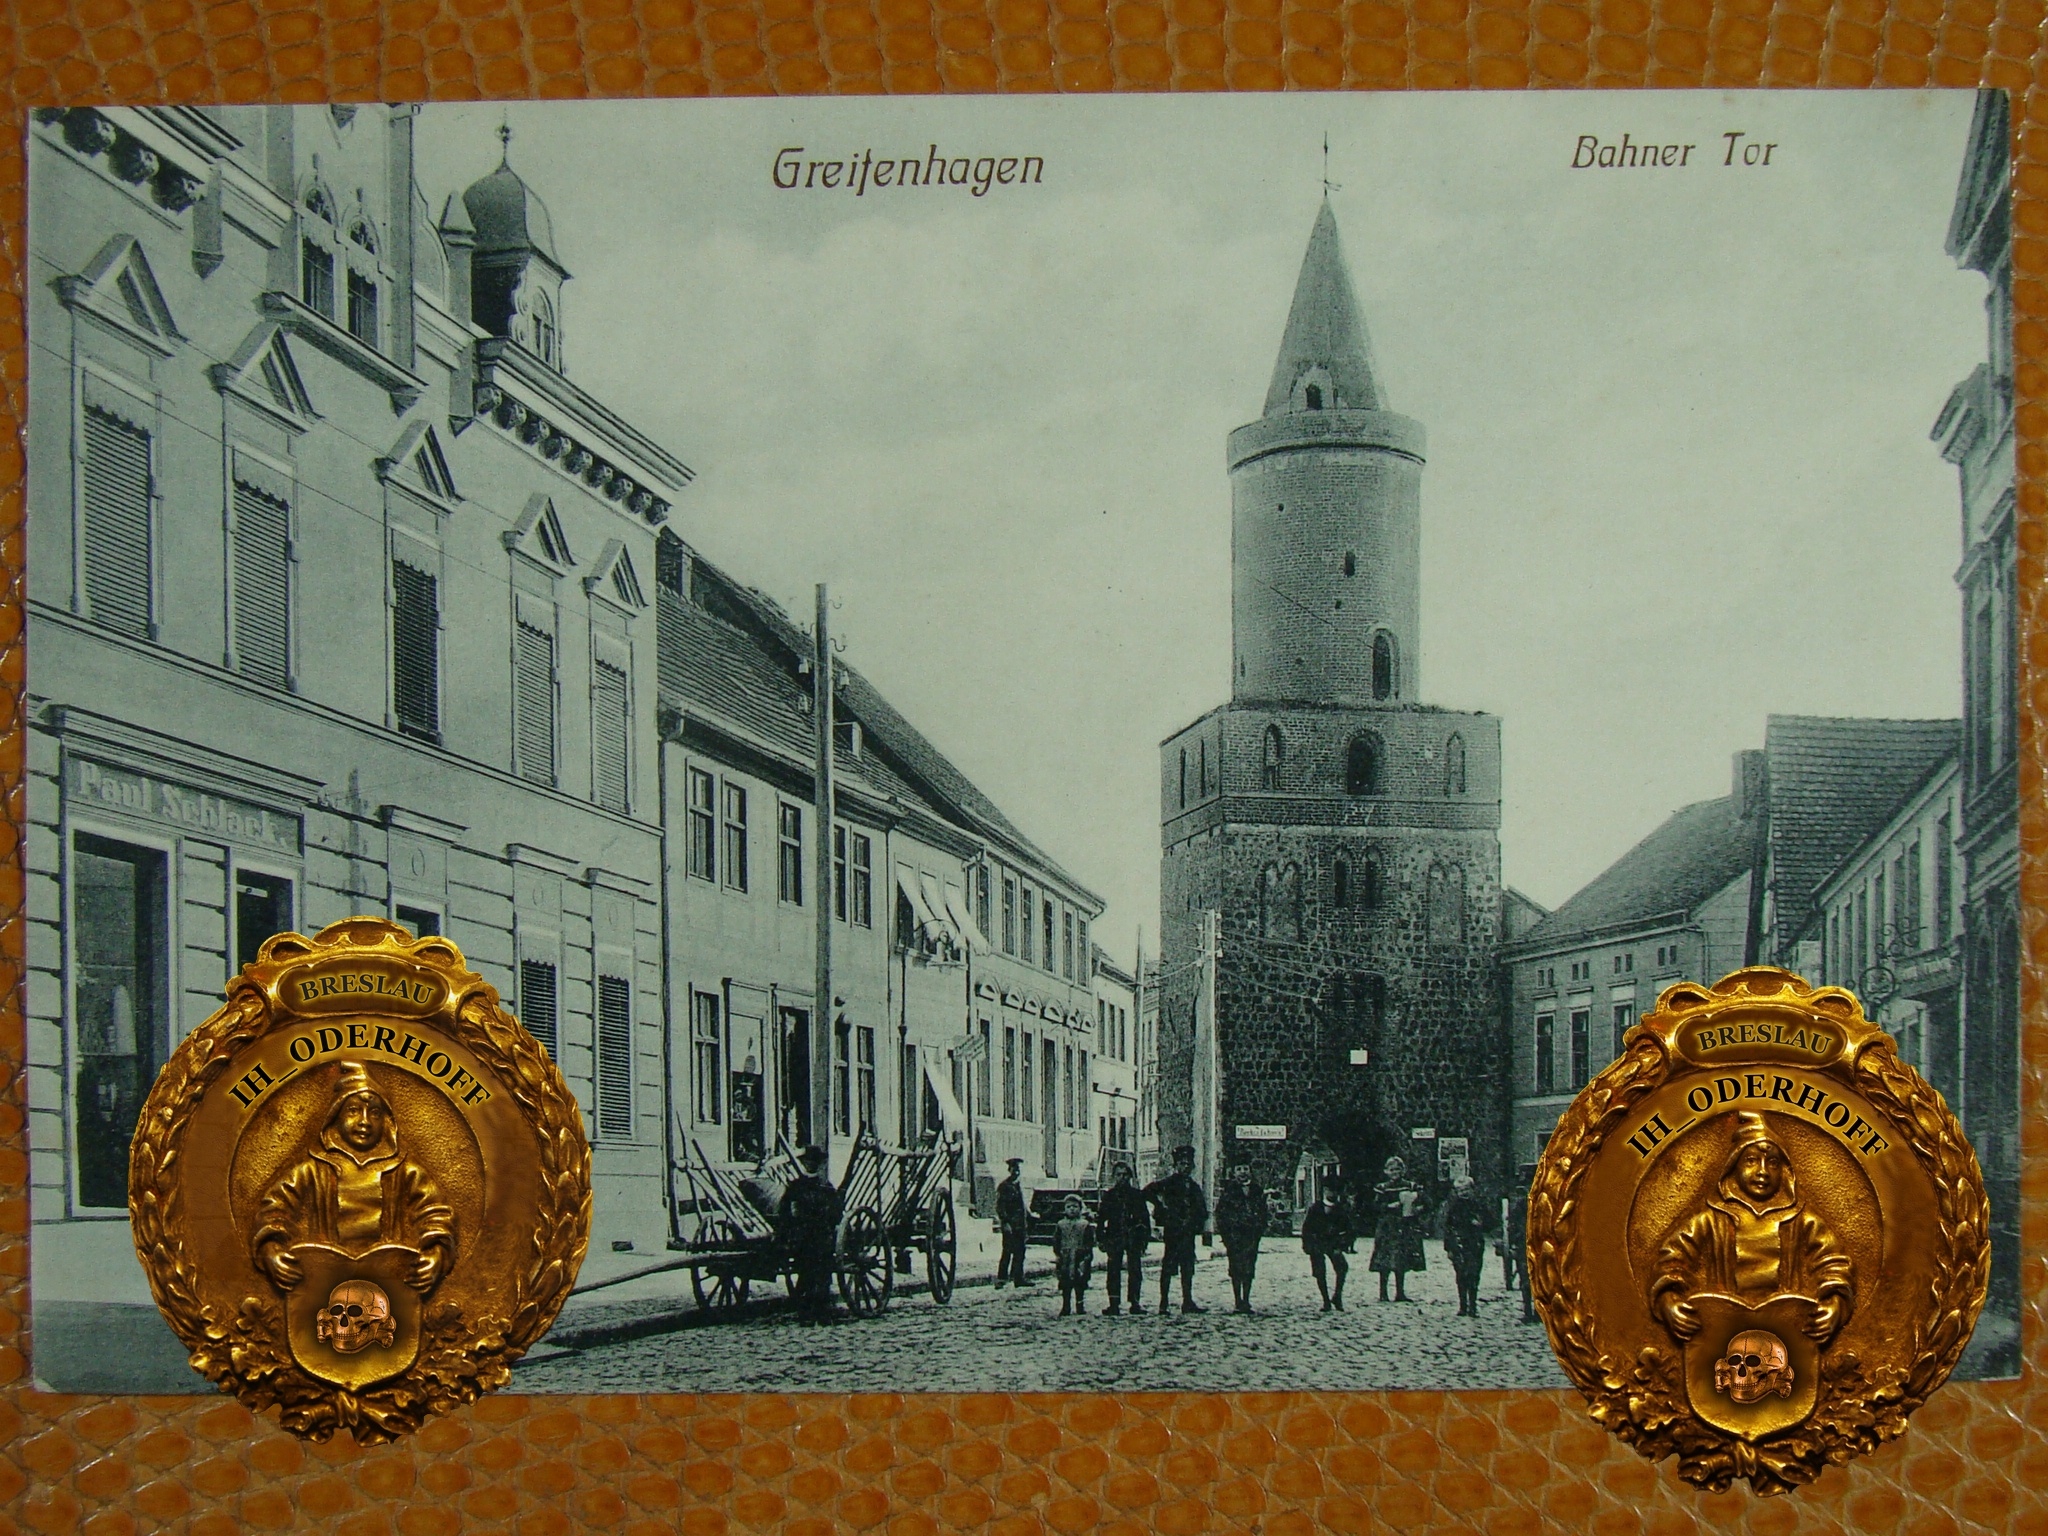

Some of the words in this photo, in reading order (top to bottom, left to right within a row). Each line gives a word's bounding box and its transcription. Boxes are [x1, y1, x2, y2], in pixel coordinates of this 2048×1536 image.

[772, 143, 1044, 197] Greifenhagen
[1570, 133, 1696, 169] Bahner
[1722, 131, 1779, 167] Tor
[77, 760, 151, 811] Paul
